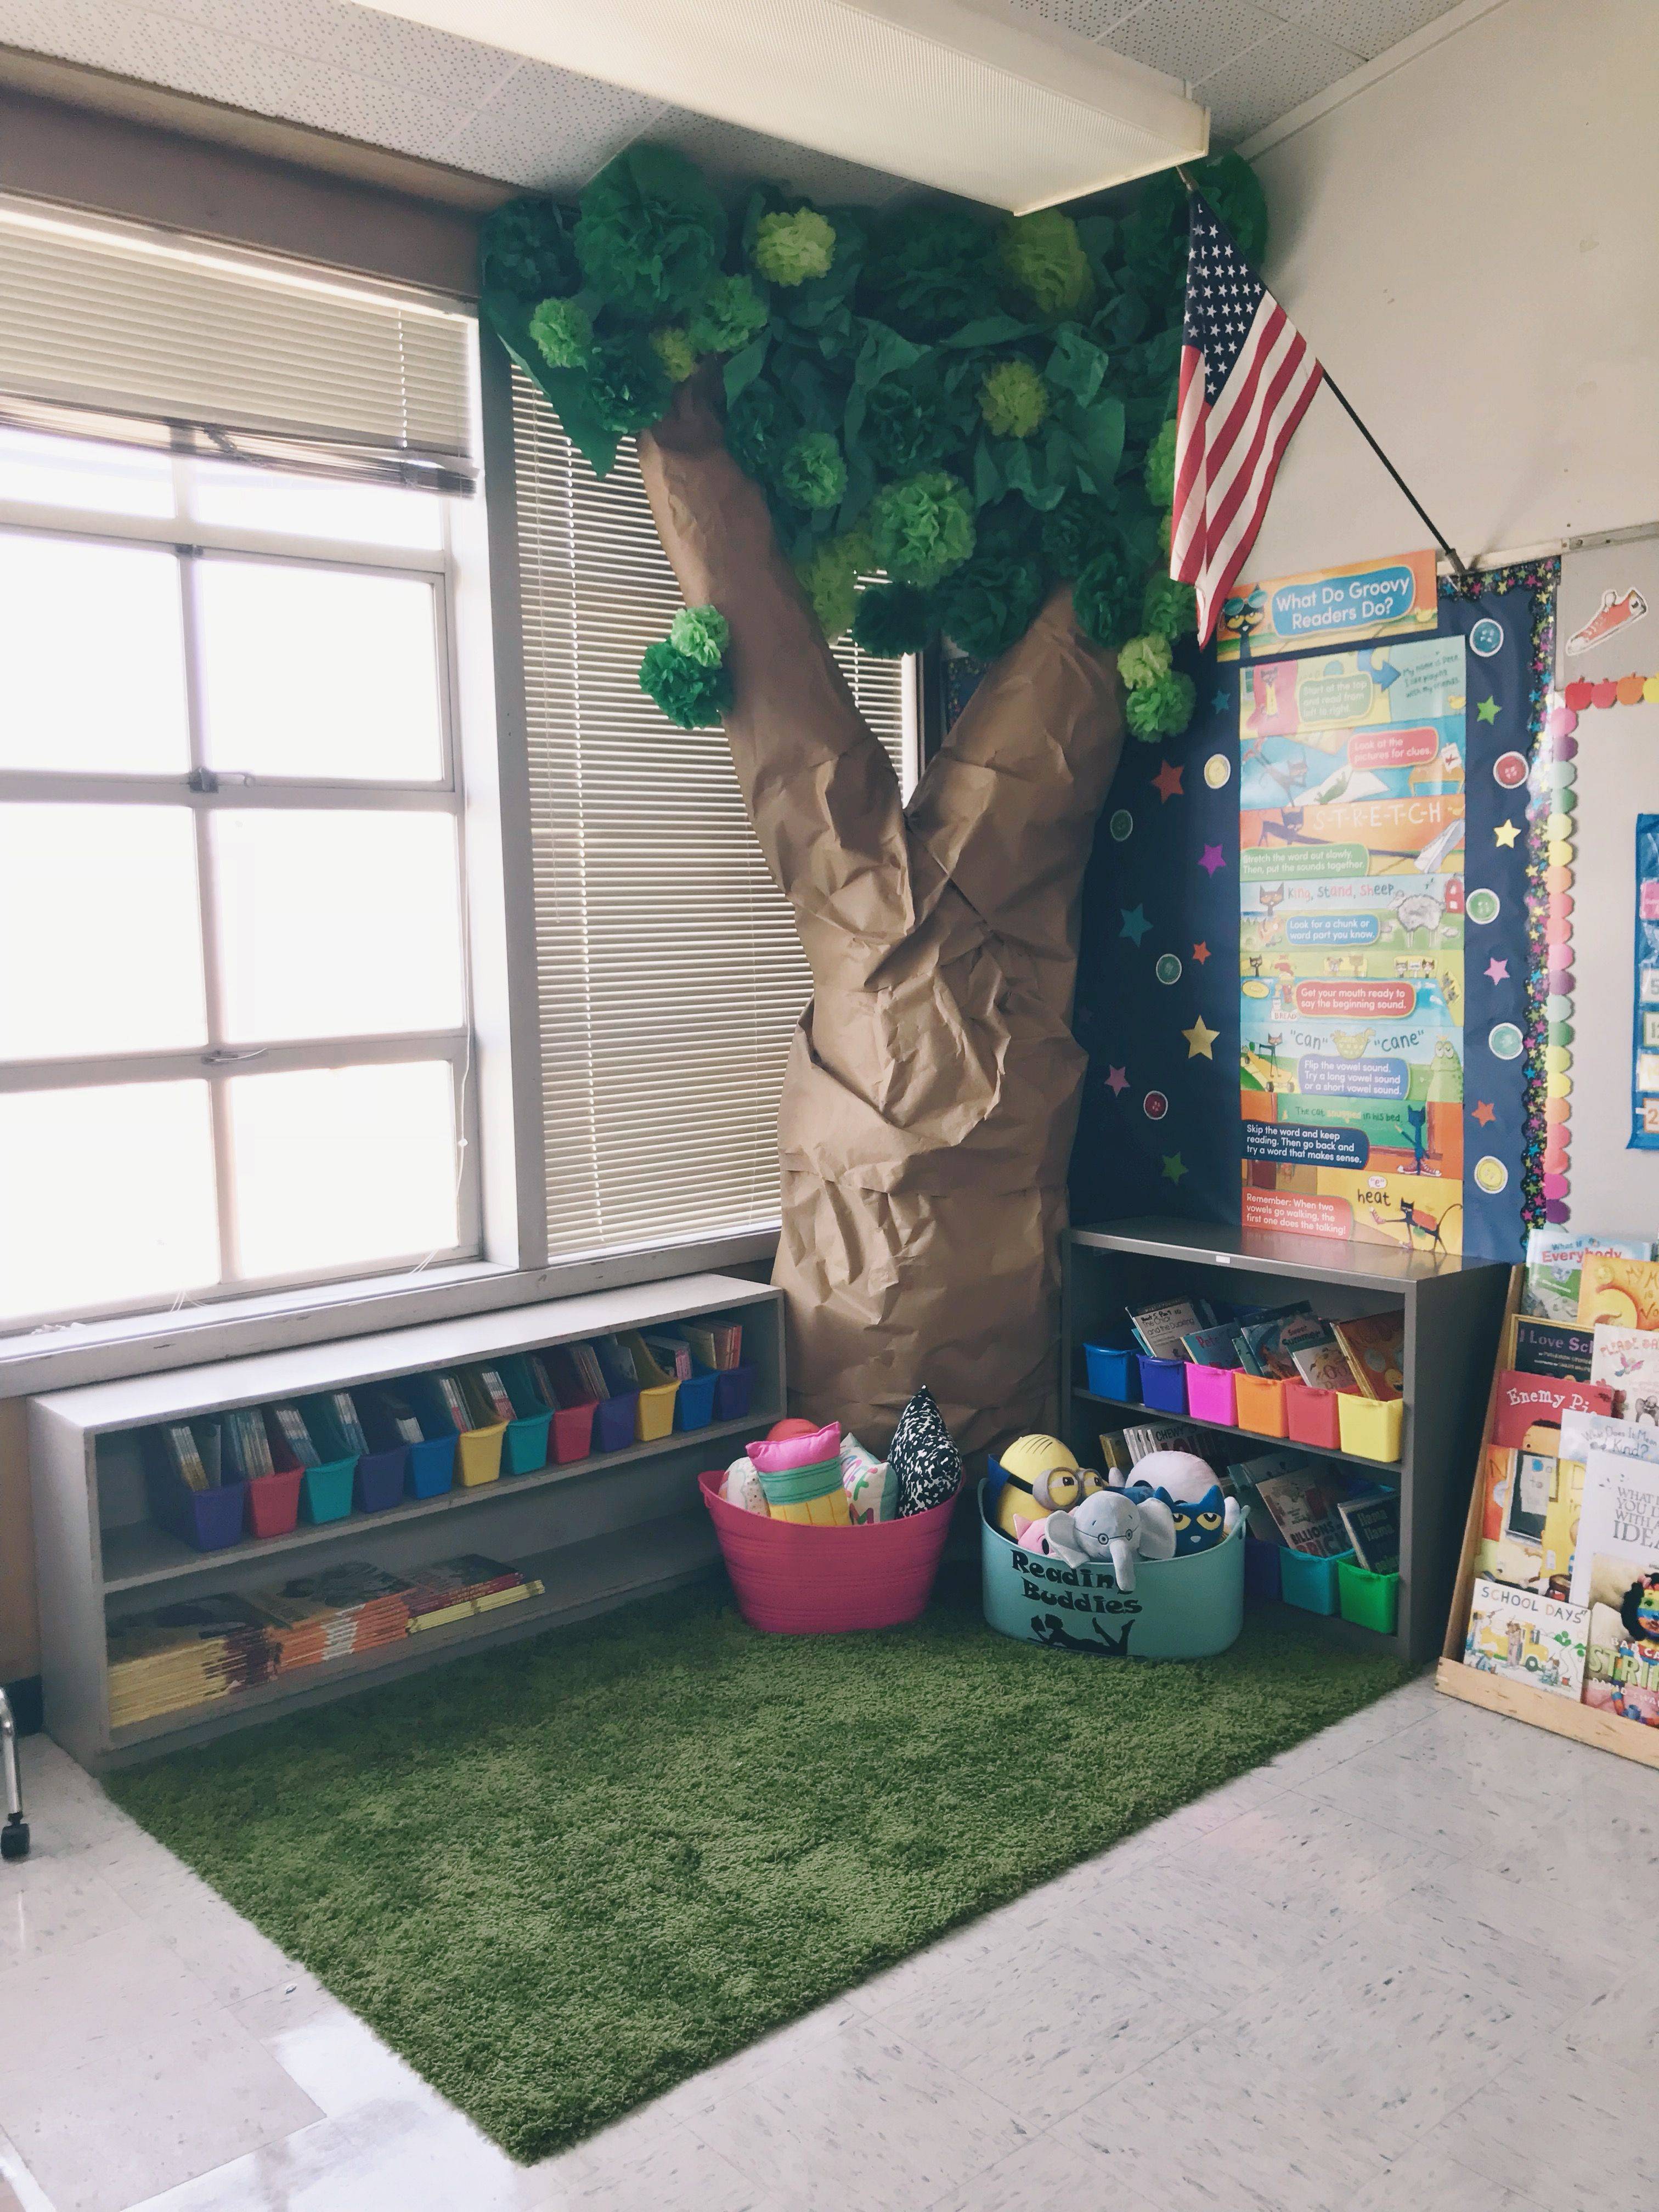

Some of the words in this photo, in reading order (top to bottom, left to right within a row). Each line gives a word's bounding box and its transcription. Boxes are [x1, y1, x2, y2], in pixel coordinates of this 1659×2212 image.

[1276, 591, 1317, 612] What
[1322, 588, 1344, 605] Do
[1349, 577, 1410, 599] Groovy
[1293, 607, 1356, 629] Readers
[1362, 596, 1393, 618] Do?
[1304, 685, 1323, 696] Start
[1325, 684, 1335, 693] at
[1337, 682, 1351, 691] the
[1352, 680, 1368, 691] top
[1304, 696, 1319, 706] and
[1322, 693, 1342, 703] read
[1344, 692, 1364, 701] from
[1304, 707, 1317, 716] left
[1319, 706, 1327, 715] to
[1355, 740, 1375, 751] Look
[1377, 739, 1387, 748] at
[1389, 737, 1404, 747] the
[1355, 752, 1390, 763] pictures
[1391, 748, 1405, 758] for
[1407, 746, 1432, 757] clues.
[1313, 800, 1441, 831] S-T-R-E-T-C-H
[1243, 853, 1271, 864] Stretch
[1272, 852, 1285, 862] the
[1288, 851, 1308, 861] word
[1310, 851, 1324, 860] out
[1243, 865, 1265, 874] Then,
[1266, 864, 1280, 876] put
[1282, 862, 1295, 872] the
[1297, 861, 1325, 871] sounds
[1327, 860, 1365, 872] together.
[1290, 920, 1309, 929] Look
[1311, 919, 1323, 928] for
[1333, 918, 1358, 928] chunk
[1360, 920, 1370, 928] or
[1290, 930, 1311, 939] word
[1312, 931, 1331, 941] part
[1333, 932, 1348, 941] you
[1350, 930, 1375, 939] know.
[1301, 988, 1317, 997] Get
[1318, 989, 1337, 998] your
[1339, 989, 1367, 997] mouth
[1368, 988, 1394, 1000] ready
[1396, 989, 1406, 998] to
[1301, 1000, 1315, 1009] say
[1317, 999, 1331, 1008] the
[1333, 998, 1375, 1011] beginning
[1378, 1000, 1407, 1009] sound.
[1274, 1012, 1297, 1020] BREAD
[1305, 1059, 1319, 1071] Flip
[1321, 1060, 1335, 1071] the
[1336, 1062, 1361, 1071] vowel
[1363, 1063, 1391, 1073] sound.
[1305, 1070, 1318, 1081] Try
[1319, 1072, 1325, 1081] a
[1327, 1071, 1346, 1084] long
[1347, 1073, 1372, 1083] vowel
[1374, 1074, 1401, 1084] sound
[1323, 1082, 1345, 1092] short
[1346, 1083, 1372, 1093] vowel
[1373, 1086, 1403, 1096] sound.
[1295, 1106, 1310, 1116] The
[1311, 1107, 1325, 1117] cat
[1363, 1112, 1372, 1120] in
[1372, 1112, 1384, 1121] his
[1246, 1124, 1264, 1136] Skip
[1265, 1126, 1278, 1136] the
[1279, 1128, 1301, 1137] word
[1302, 1130, 1319, 1139] and
[1320, 1130, 1341, 1143] keep
[1246, 1135, 1279, 1148] reading.
[1280, 1137, 1301, 1147] Then
[1303, 1141, 1314, 1150] go
[1316, 1141, 1336, 1151] back
[1338, 1142, 1355, 1153] and
[1246, 1145, 1259, 1156] try
[1267, 1148, 1288, 1156] word
[1289, 1148, 1306, 1159] that
[1307, 1152, 1335, 1161] makes
[1336, 1154, 1363, 1164] sense.
[1246, 1193, 1292, 1207] Remember:
[1293, 1198, 1317, 1210] When
[1318, 1201, 1334, 1212] two
[1357, 1187, 1392, 1207] heat
[1246, 1204, 1273, 1215] vowels
[1274, 1207, 1285, 1216] go
[1286, 1209, 1320, 1222] walking,
[1322, 1212, 1335, 1222] the
[1246, 1213, 1262, 1223] first
[1263, 1217, 1278, 1226] one
[1279, 1217, 1300, 1228] does
[1301, 1220, 1315, 1229] the
[1316, 1223, 1347, 1237] talking!
[1160, 1323, 1171, 1333] the
[1519, 1328, 1526, 1343] I
[1530, 1330, 1565, 1350] Love
[1506, 1387, 1566, 1408] Enemy
[1572, 1393, 1598, 1414] Pi
[1155, 1426, 1184, 1442] CHEWY
[1612, 1438, 1650, 1459] Kind?
[1617, 1486, 1655, 1504] WHAT
[1617, 1497, 1647, 1515] YOU
[1615, 1509, 1651, 1527] WITH
[1290, 1521, 1336, 1545] BILLIONS
[1021, 1576, 1143, 1614] Buddies
[1481, 1586, 1539, 1613] SCHOOL
[1545, 1607, 1583, 1624] DAYS
[1611, 1636, 1640, 1653] BAD
